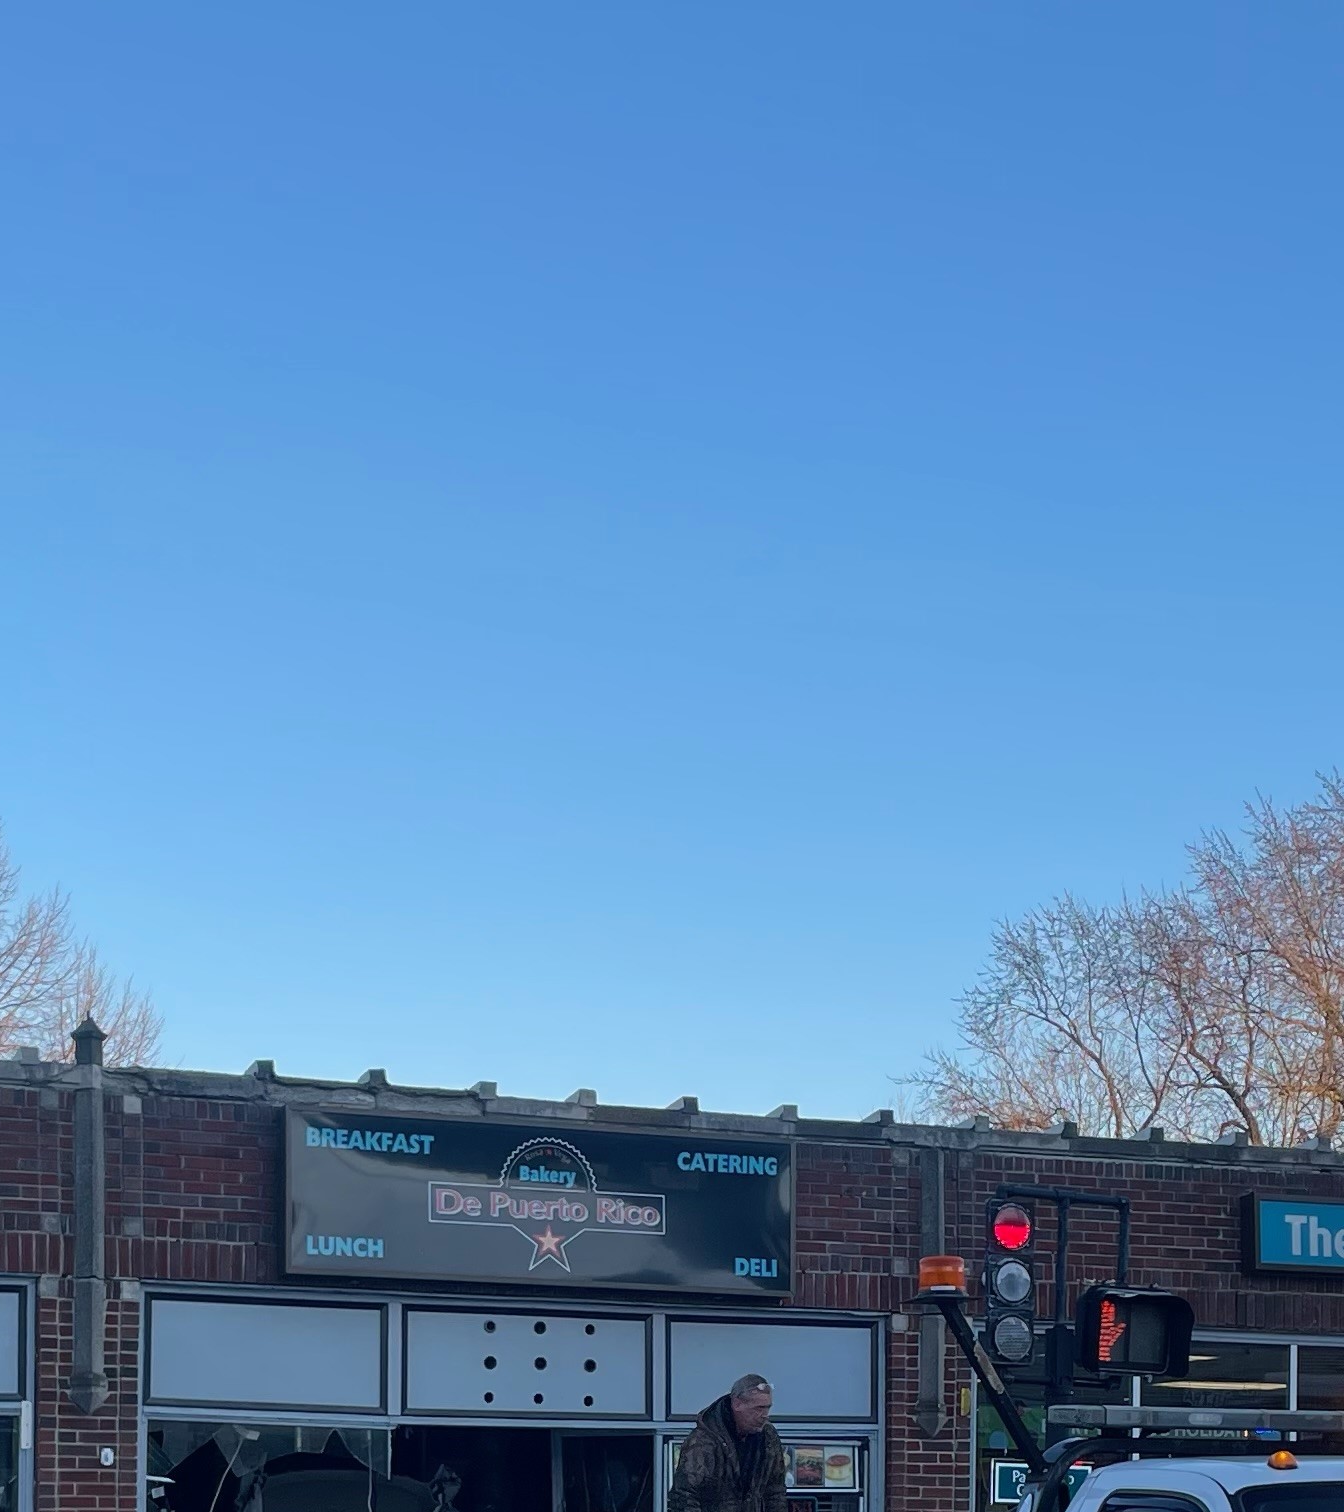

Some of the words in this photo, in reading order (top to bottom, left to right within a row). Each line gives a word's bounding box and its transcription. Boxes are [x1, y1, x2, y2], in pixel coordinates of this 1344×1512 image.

[306, 1127, 434, 1156] BREAKFAST
[677, 1151, 778, 1176] CATERING
[519, 1165, 576, 1188] Bakery
[435, 1188, 483, 1216] De
[489, 1191, 588, 1222] Puerto
[596, 1197, 661, 1226] Rico
[306, 1236, 384, 1259] LUNCH
[734, 1257, 778, 1278] DELI
